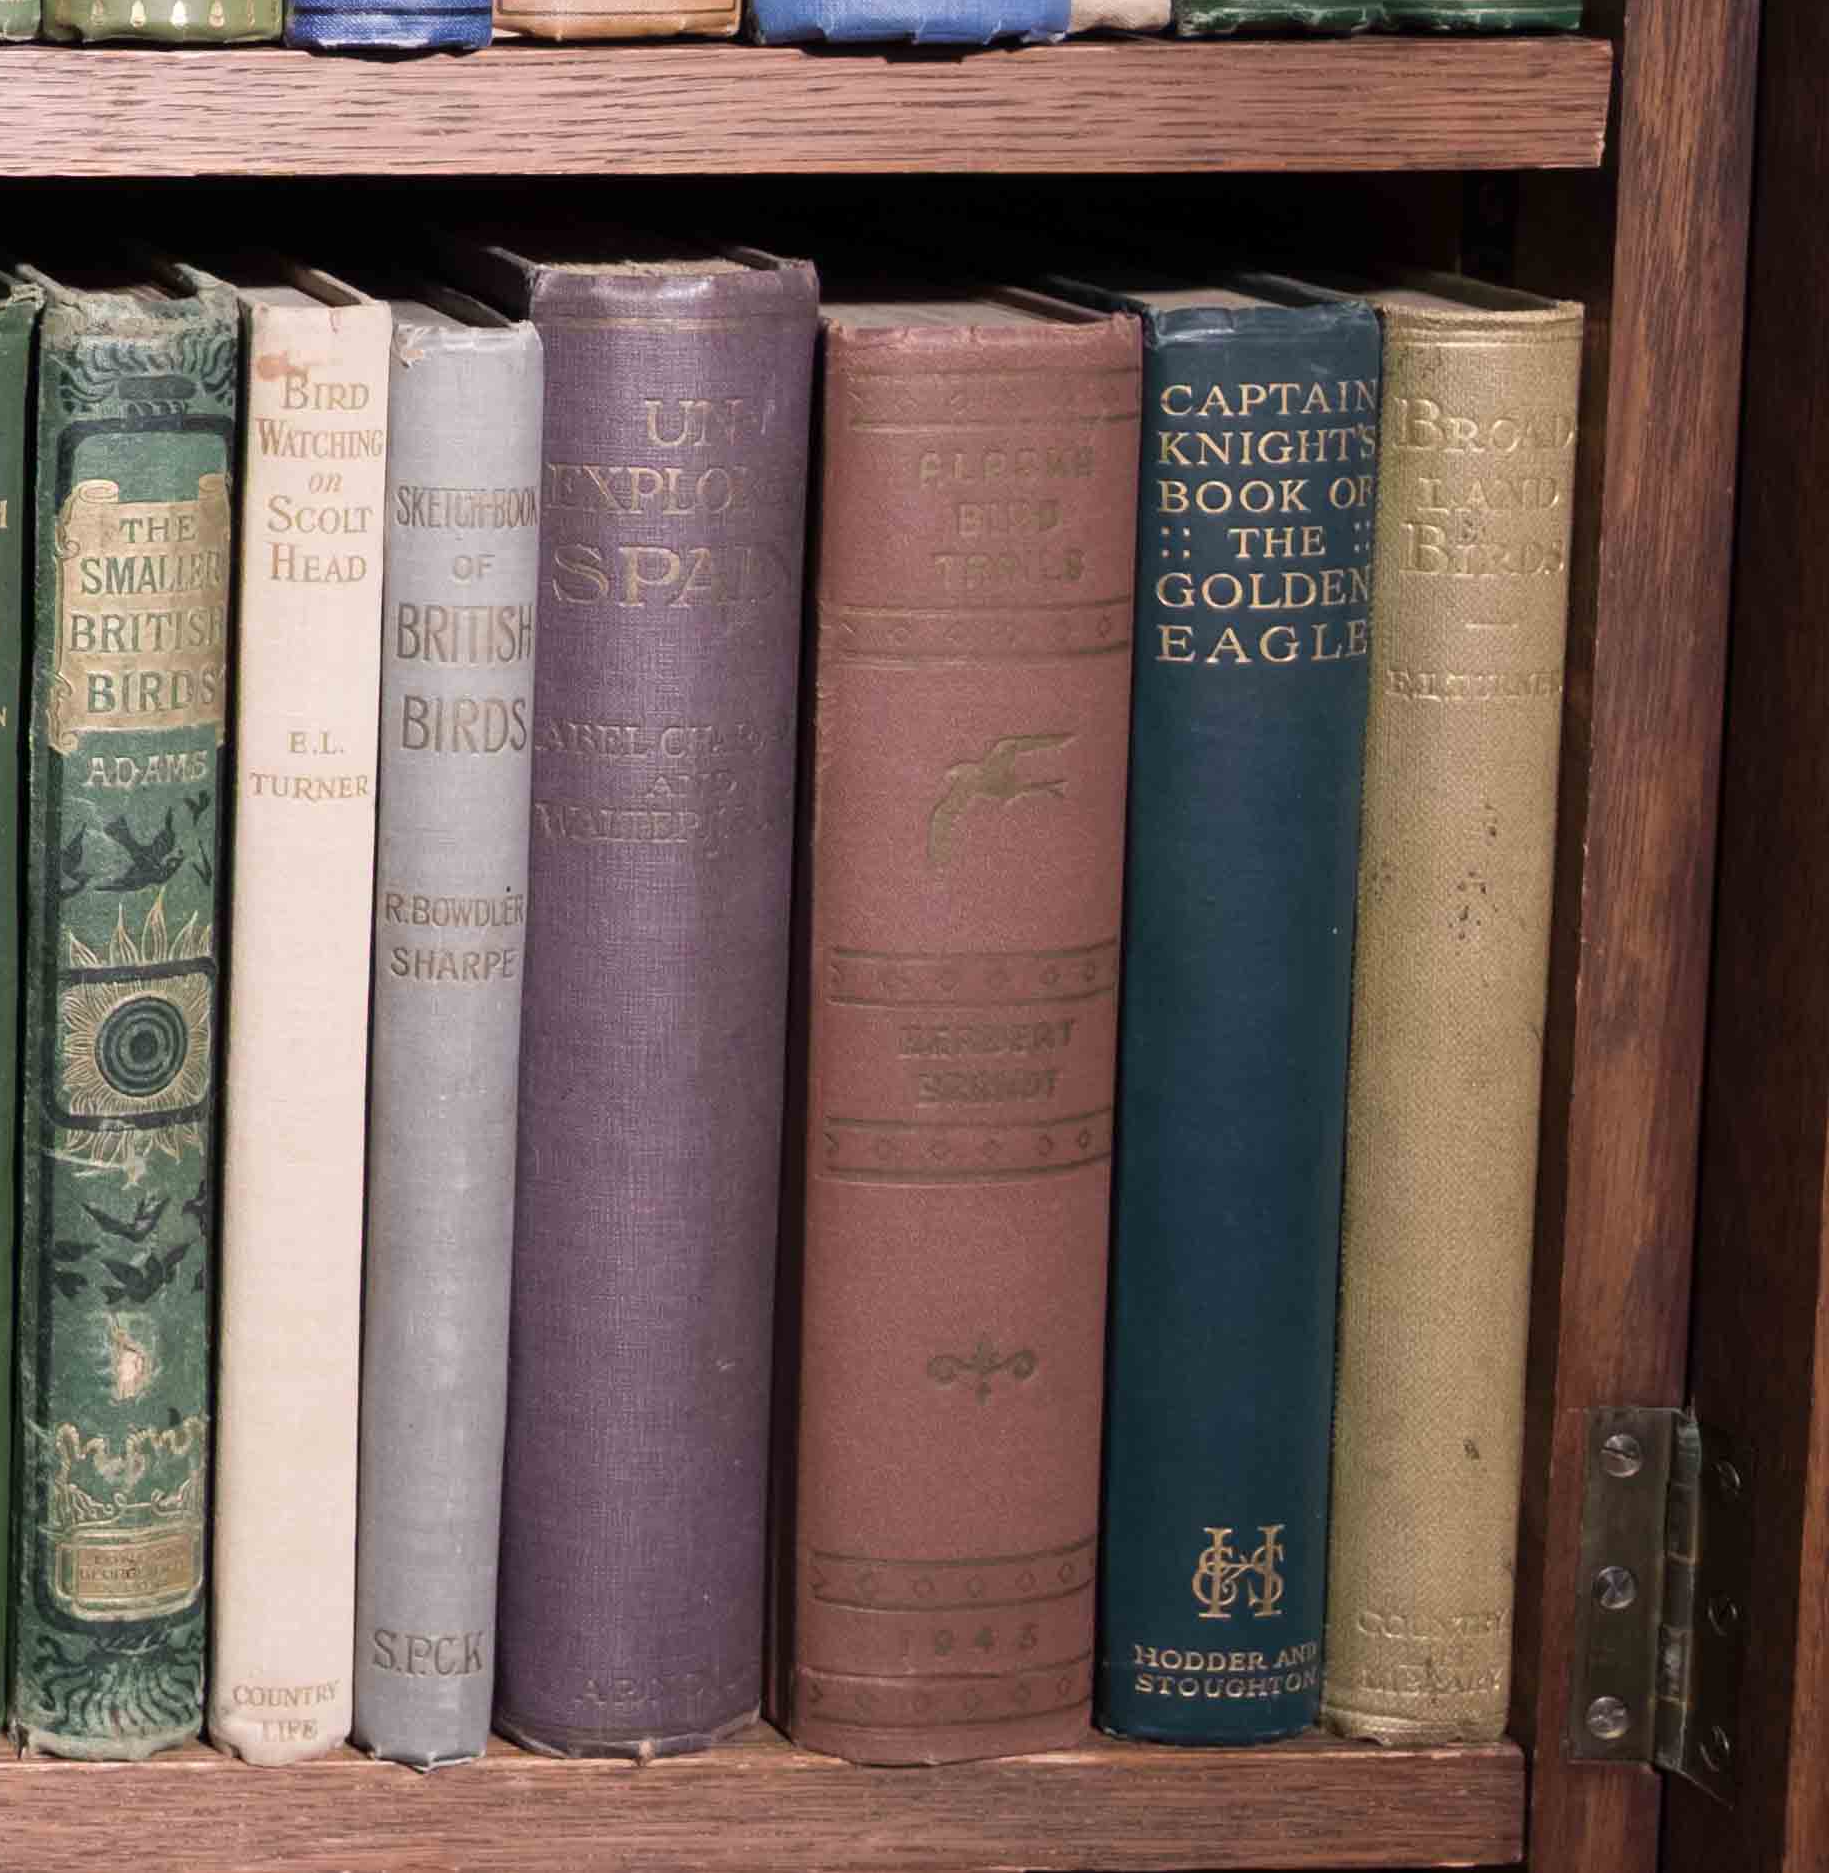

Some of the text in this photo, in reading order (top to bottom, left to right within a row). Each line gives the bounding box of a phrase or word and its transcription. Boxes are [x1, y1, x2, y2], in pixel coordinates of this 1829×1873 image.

[281, 375, 371, 412] BIRD
[1160, 379, 1377, 419] CAPTAIN
[254, 417, 384, 460] WATCHING
[267, 494, 374, 535] SCOLT
[1160, 480, 1310, 514] BOOK
[120, 515, 196, 544] THE
[1227, 525, 1327, 560] THE
[269, 542, 368, 584] HEAD
[451, 554, 493, 582] OF
[1155, 571, 1371, 610] GOLDEN
[1156, 619, 1368, 664] EAGLE
[402, 694, 528, 754] BIRDS
[87, 750, 207, 788] ADAMS
[250, 772, 369, 803] TURNER
[390, 948, 515, 982] SHARPE
[1133, 1641, 1317, 1672] HODDER AND
[232, 1680, 339, 1710] COUNTRY
[1133, 1668, 1316, 1699] STOUGHTON
